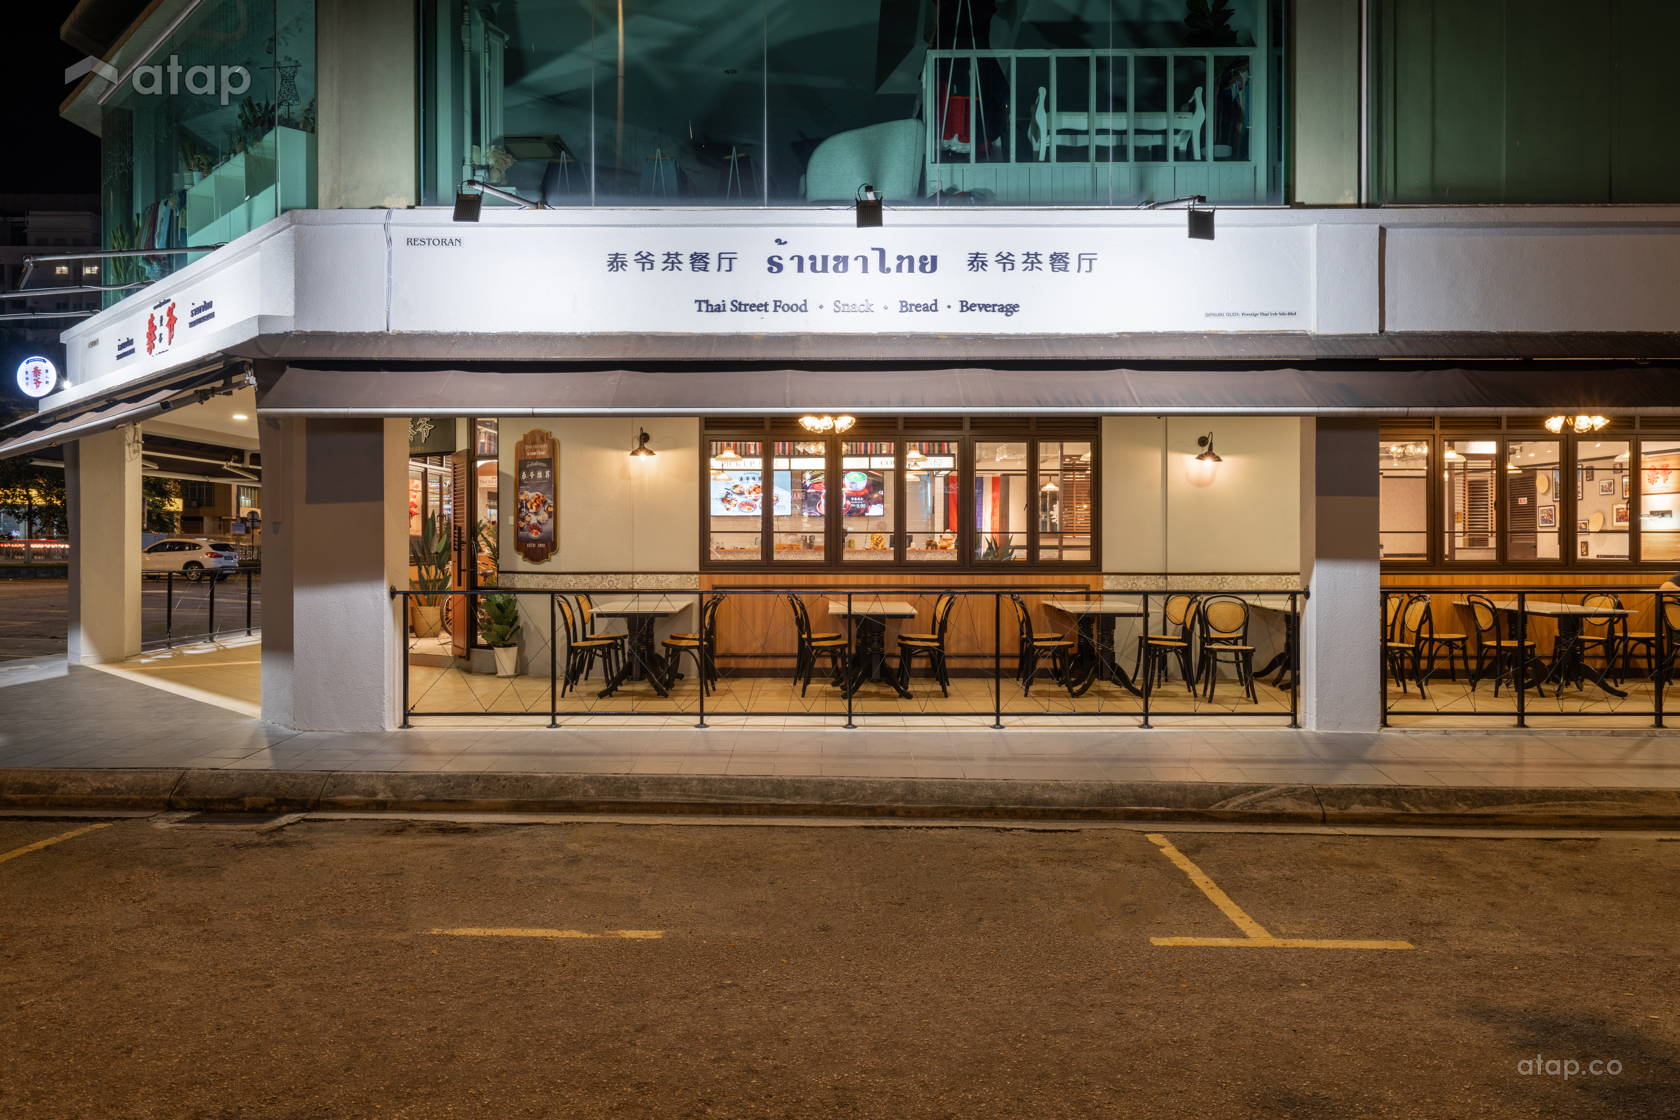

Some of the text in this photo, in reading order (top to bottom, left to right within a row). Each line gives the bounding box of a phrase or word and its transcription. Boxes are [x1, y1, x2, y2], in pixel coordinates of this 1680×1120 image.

[406, 237, 463, 247] RESTORAN
[607, 250, 738, 273] 泰爷茶餐厅
[767, 238, 939, 274] ร้านชาไทย
[967, 250, 1098, 273] 泰爷茶餐厅
[694, 299, 1021, 317] Thai Street Food Snack Bread Beverage
